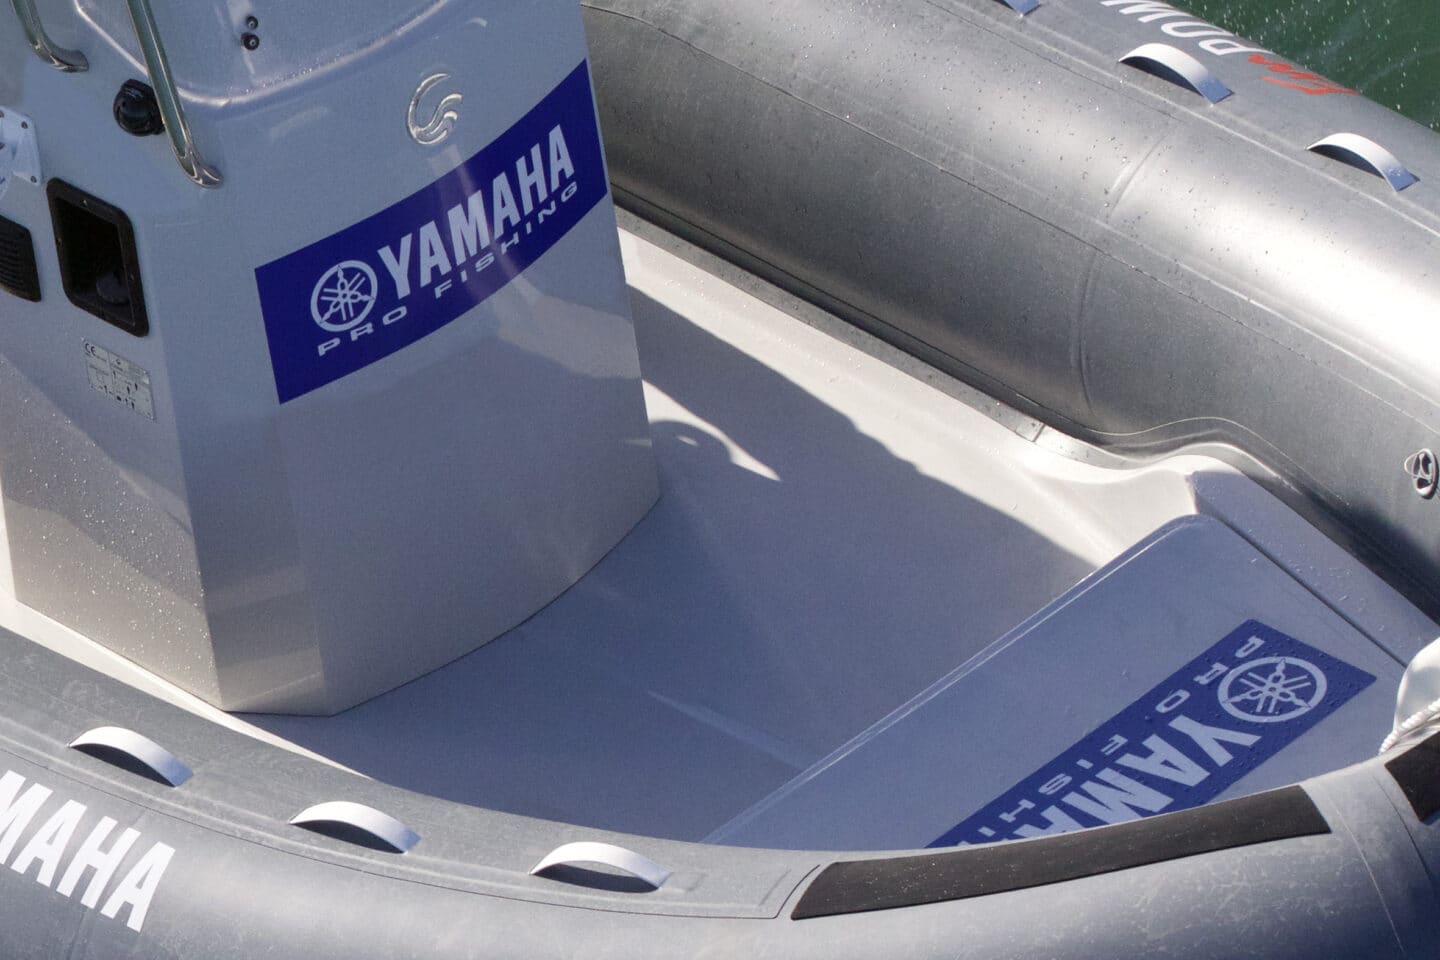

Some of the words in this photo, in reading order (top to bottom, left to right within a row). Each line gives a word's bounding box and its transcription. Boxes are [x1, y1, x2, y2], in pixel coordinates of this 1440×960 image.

[317, 305, 408, 357] PRO
[433, 181, 579, 299] FISHING
[377, 123, 575, 300] YAMAHA
[1155, 635, 1264, 714] PRO
[958, 734, 1128, 846] FISHI
[1002, 715, 1261, 840] YAMA
